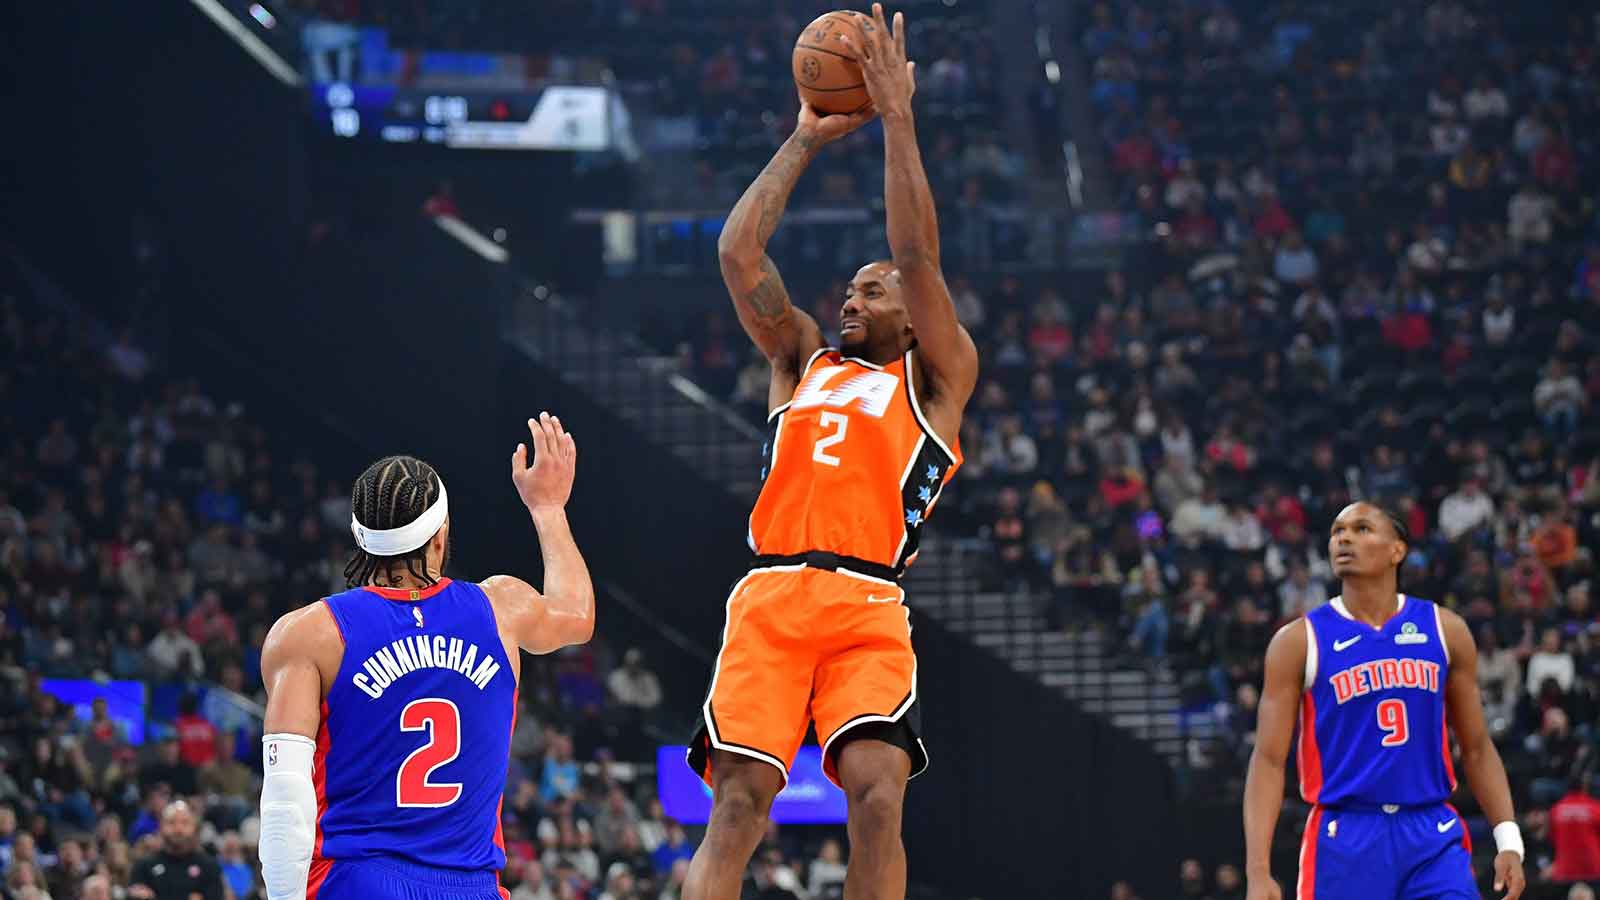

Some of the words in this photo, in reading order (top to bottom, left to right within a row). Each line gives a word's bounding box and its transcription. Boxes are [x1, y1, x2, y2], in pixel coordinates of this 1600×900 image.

[790, 366, 900, 418] LA
[812, 410, 849, 467] 2
[352, 635, 500, 700] CUNNINGHAM
[1329, 658, 1441, 705] DETROIT
[1376, 698, 1409, 747] 9
[396, 697, 463, 808] 2
